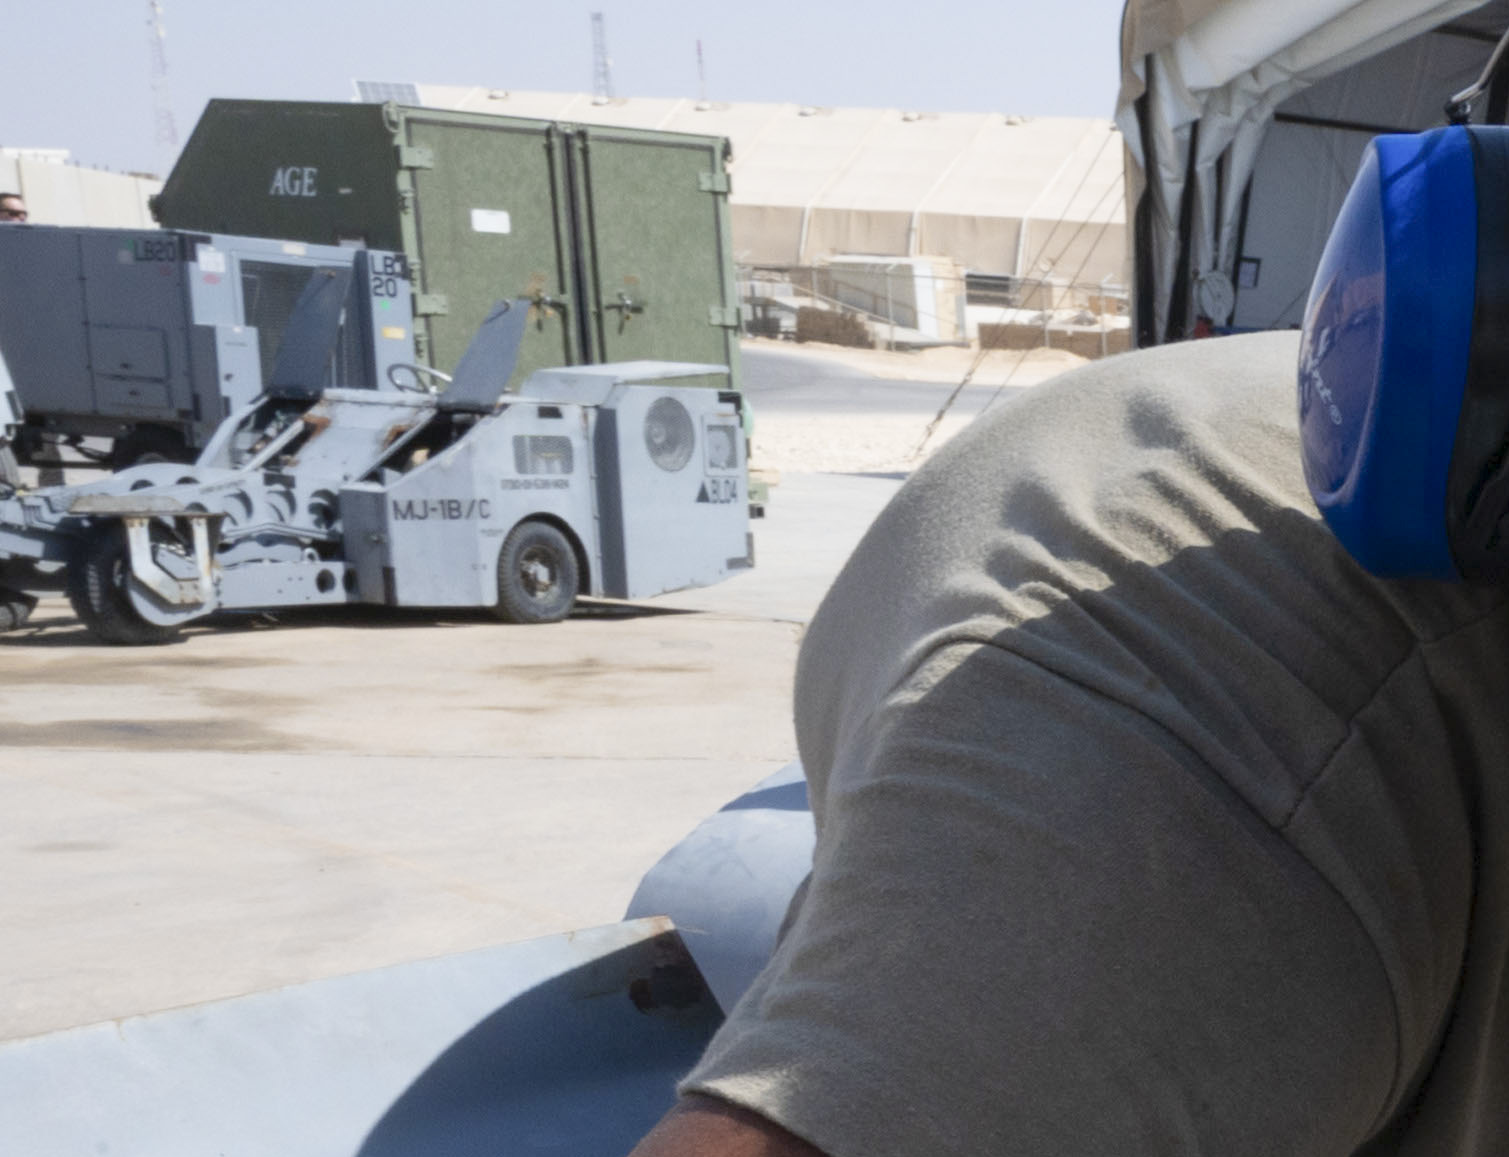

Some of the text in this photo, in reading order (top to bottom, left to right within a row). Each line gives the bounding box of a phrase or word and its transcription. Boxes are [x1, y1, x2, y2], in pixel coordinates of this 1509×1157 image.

[270, 167, 318, 197] AGE
[370, 254, 395, 276] LB
[371, 277, 397, 298] 20
